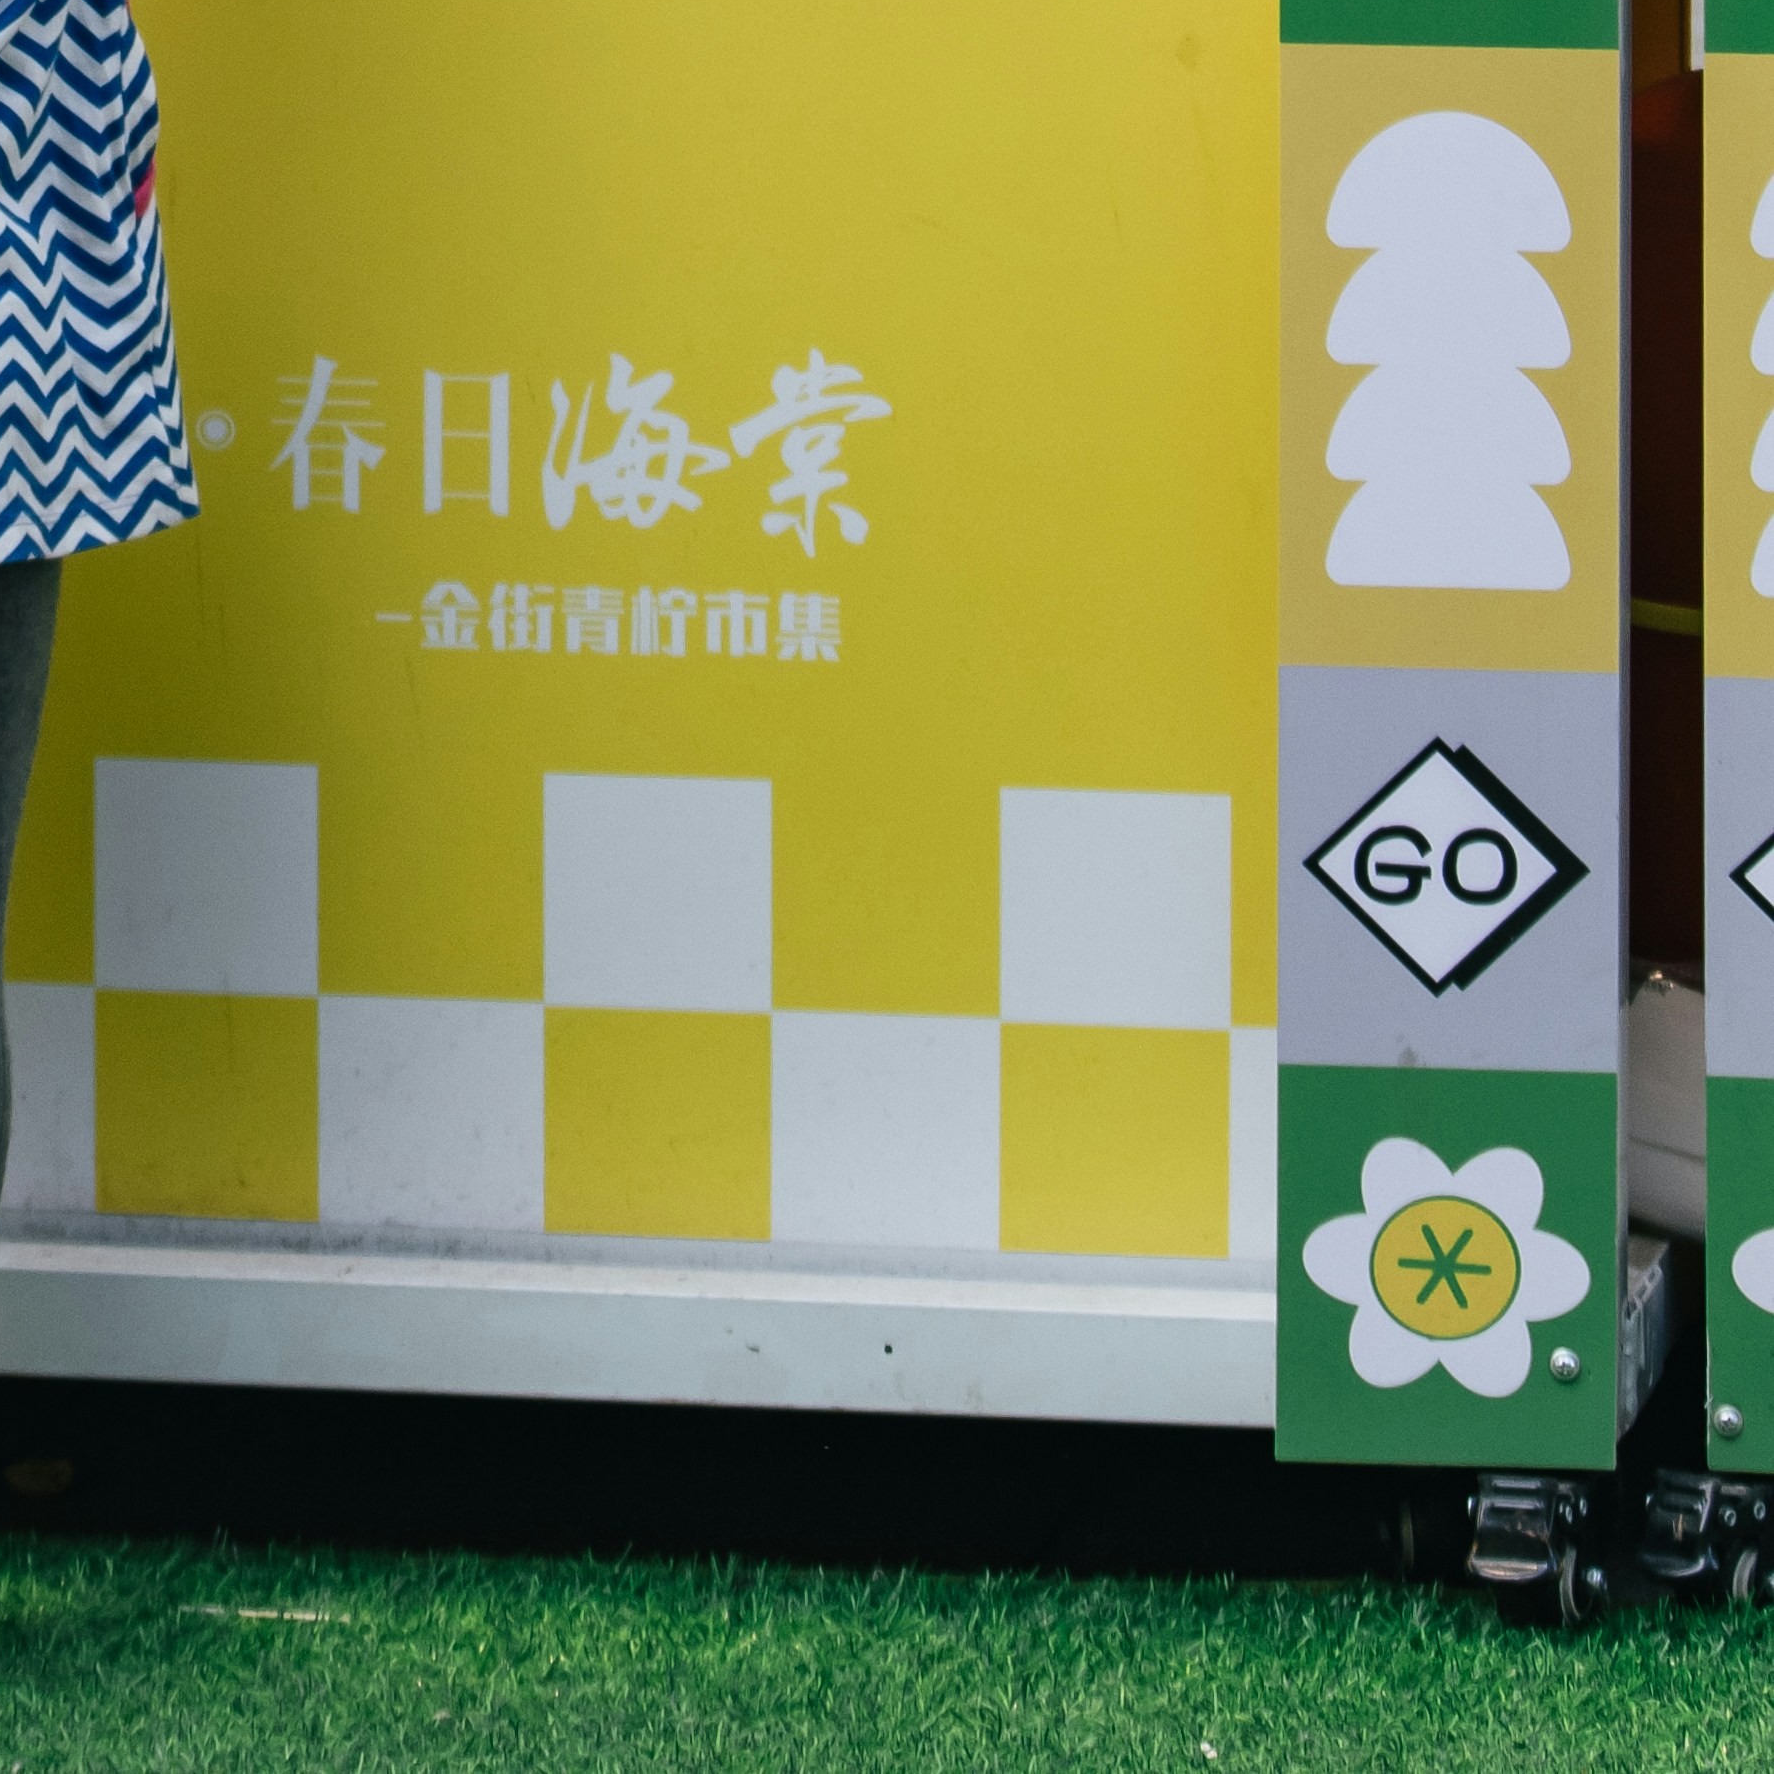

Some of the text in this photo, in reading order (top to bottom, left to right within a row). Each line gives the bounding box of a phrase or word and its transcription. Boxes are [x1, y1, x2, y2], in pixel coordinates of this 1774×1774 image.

[269, 348, 893, 558] 春日海棠
[1354, 825, 1518, 906] GO
